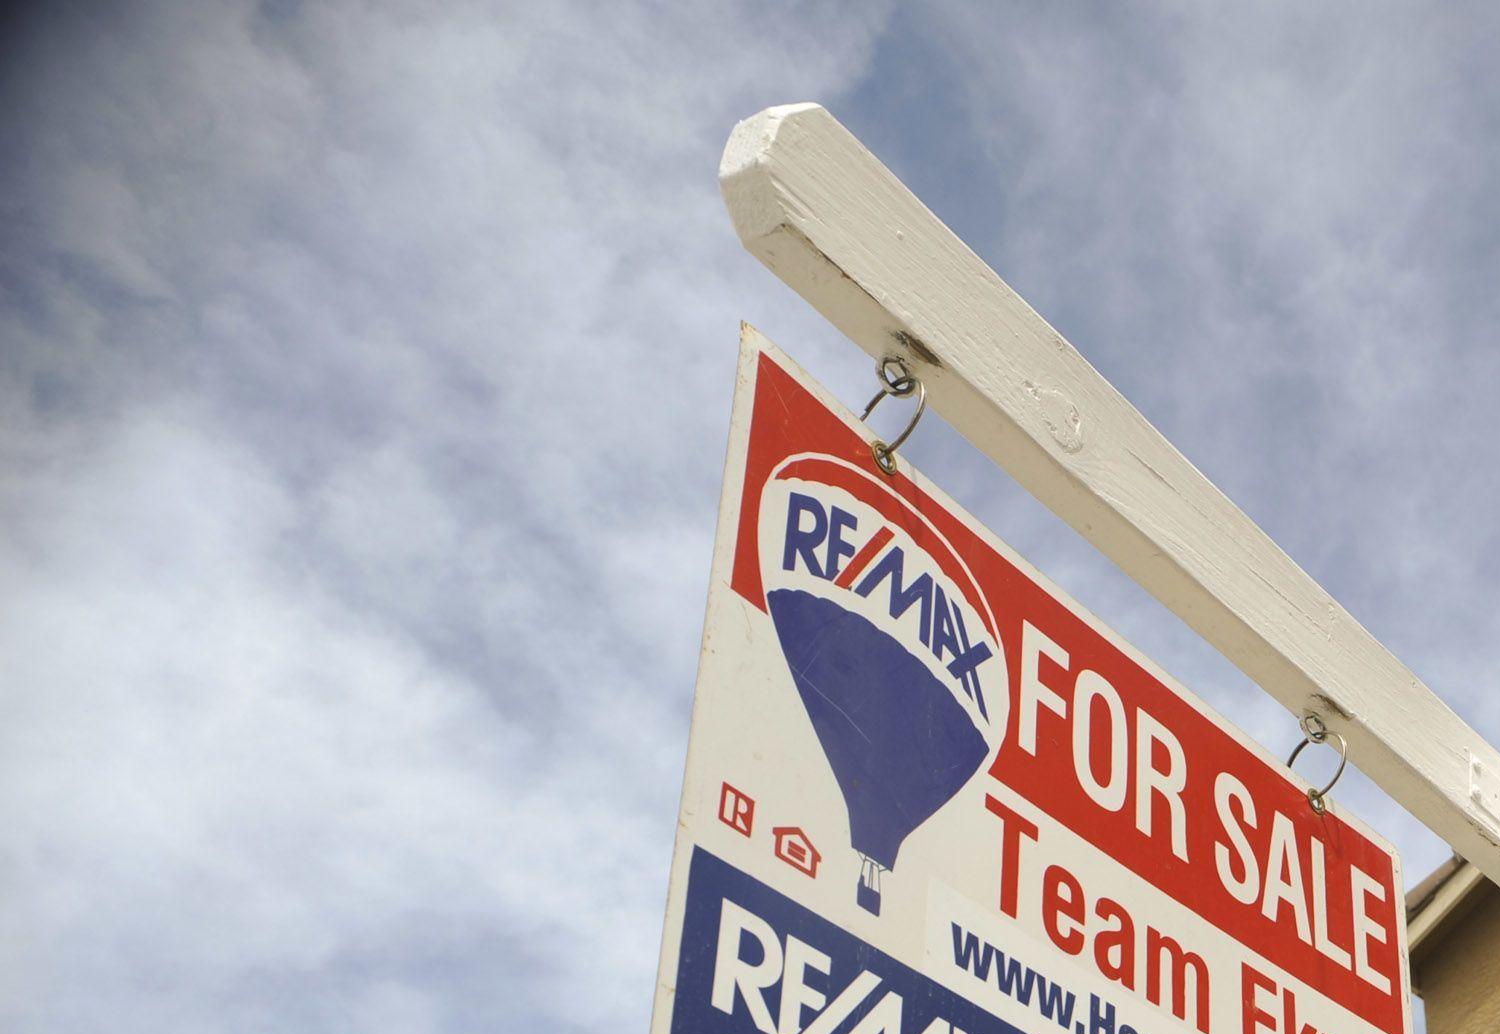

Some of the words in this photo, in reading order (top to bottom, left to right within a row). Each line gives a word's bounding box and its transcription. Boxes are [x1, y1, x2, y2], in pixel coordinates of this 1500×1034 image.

[783, 493, 993, 726] RE/MAX
[985, 796, 1210, 1034] Team
[1018, 619, 1189, 863] FOR
[1213, 772, 1393, 995] SALE
